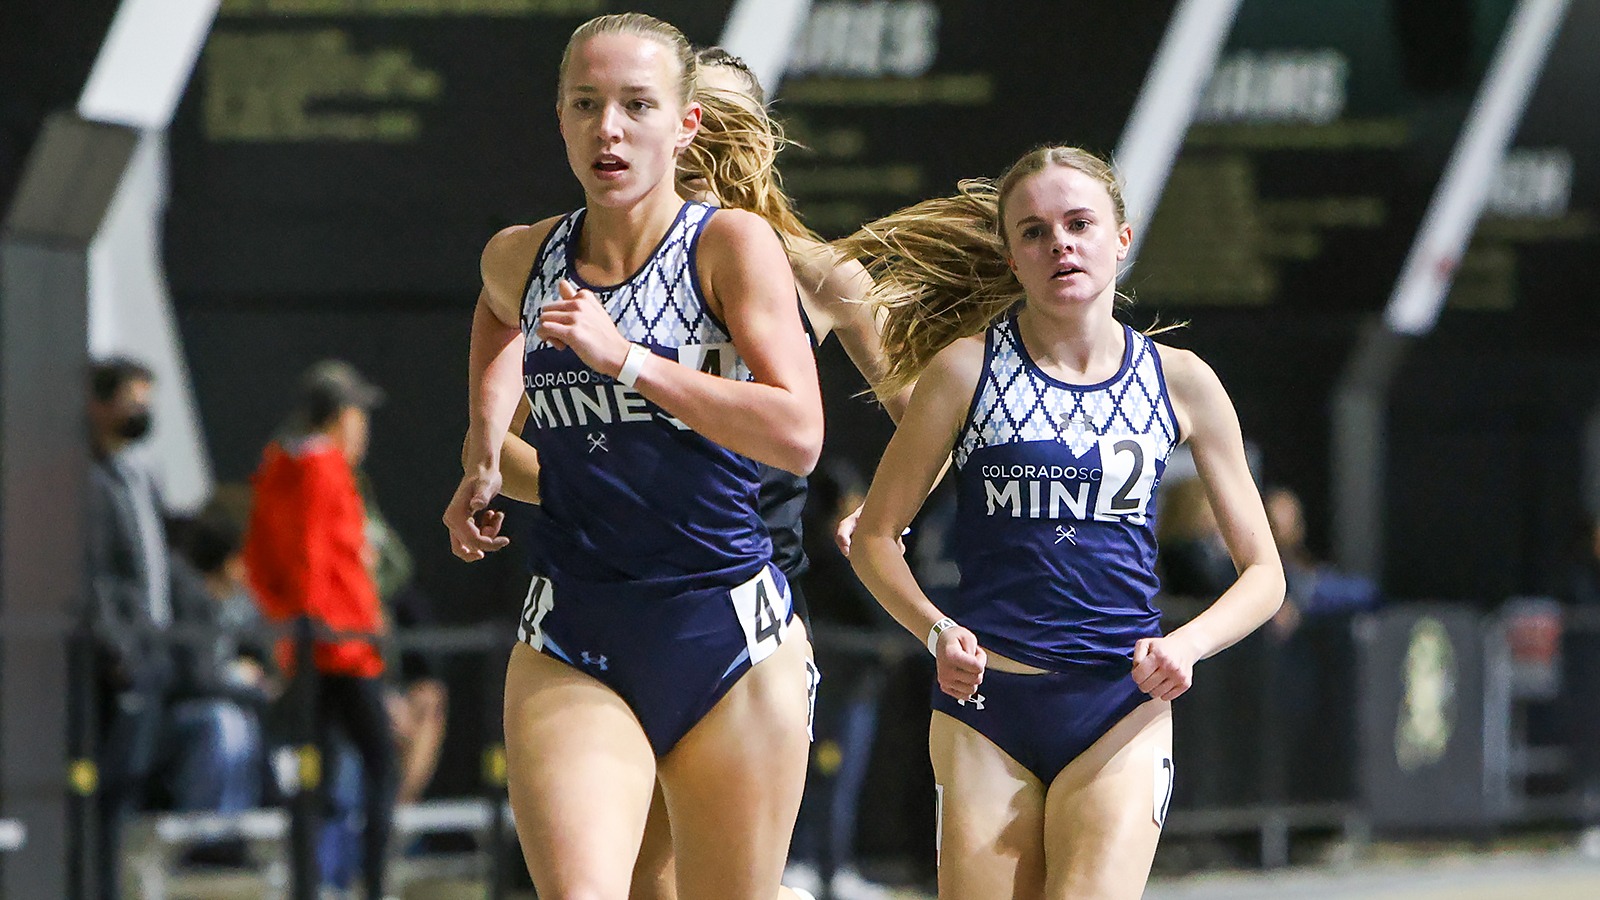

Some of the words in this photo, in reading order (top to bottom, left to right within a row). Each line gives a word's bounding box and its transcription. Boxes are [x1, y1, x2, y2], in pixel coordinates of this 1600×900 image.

[984, 480, 1147, 526] MIN
[1110, 439, 1144, 510] 2
[755, 578, 782, 646] 4
